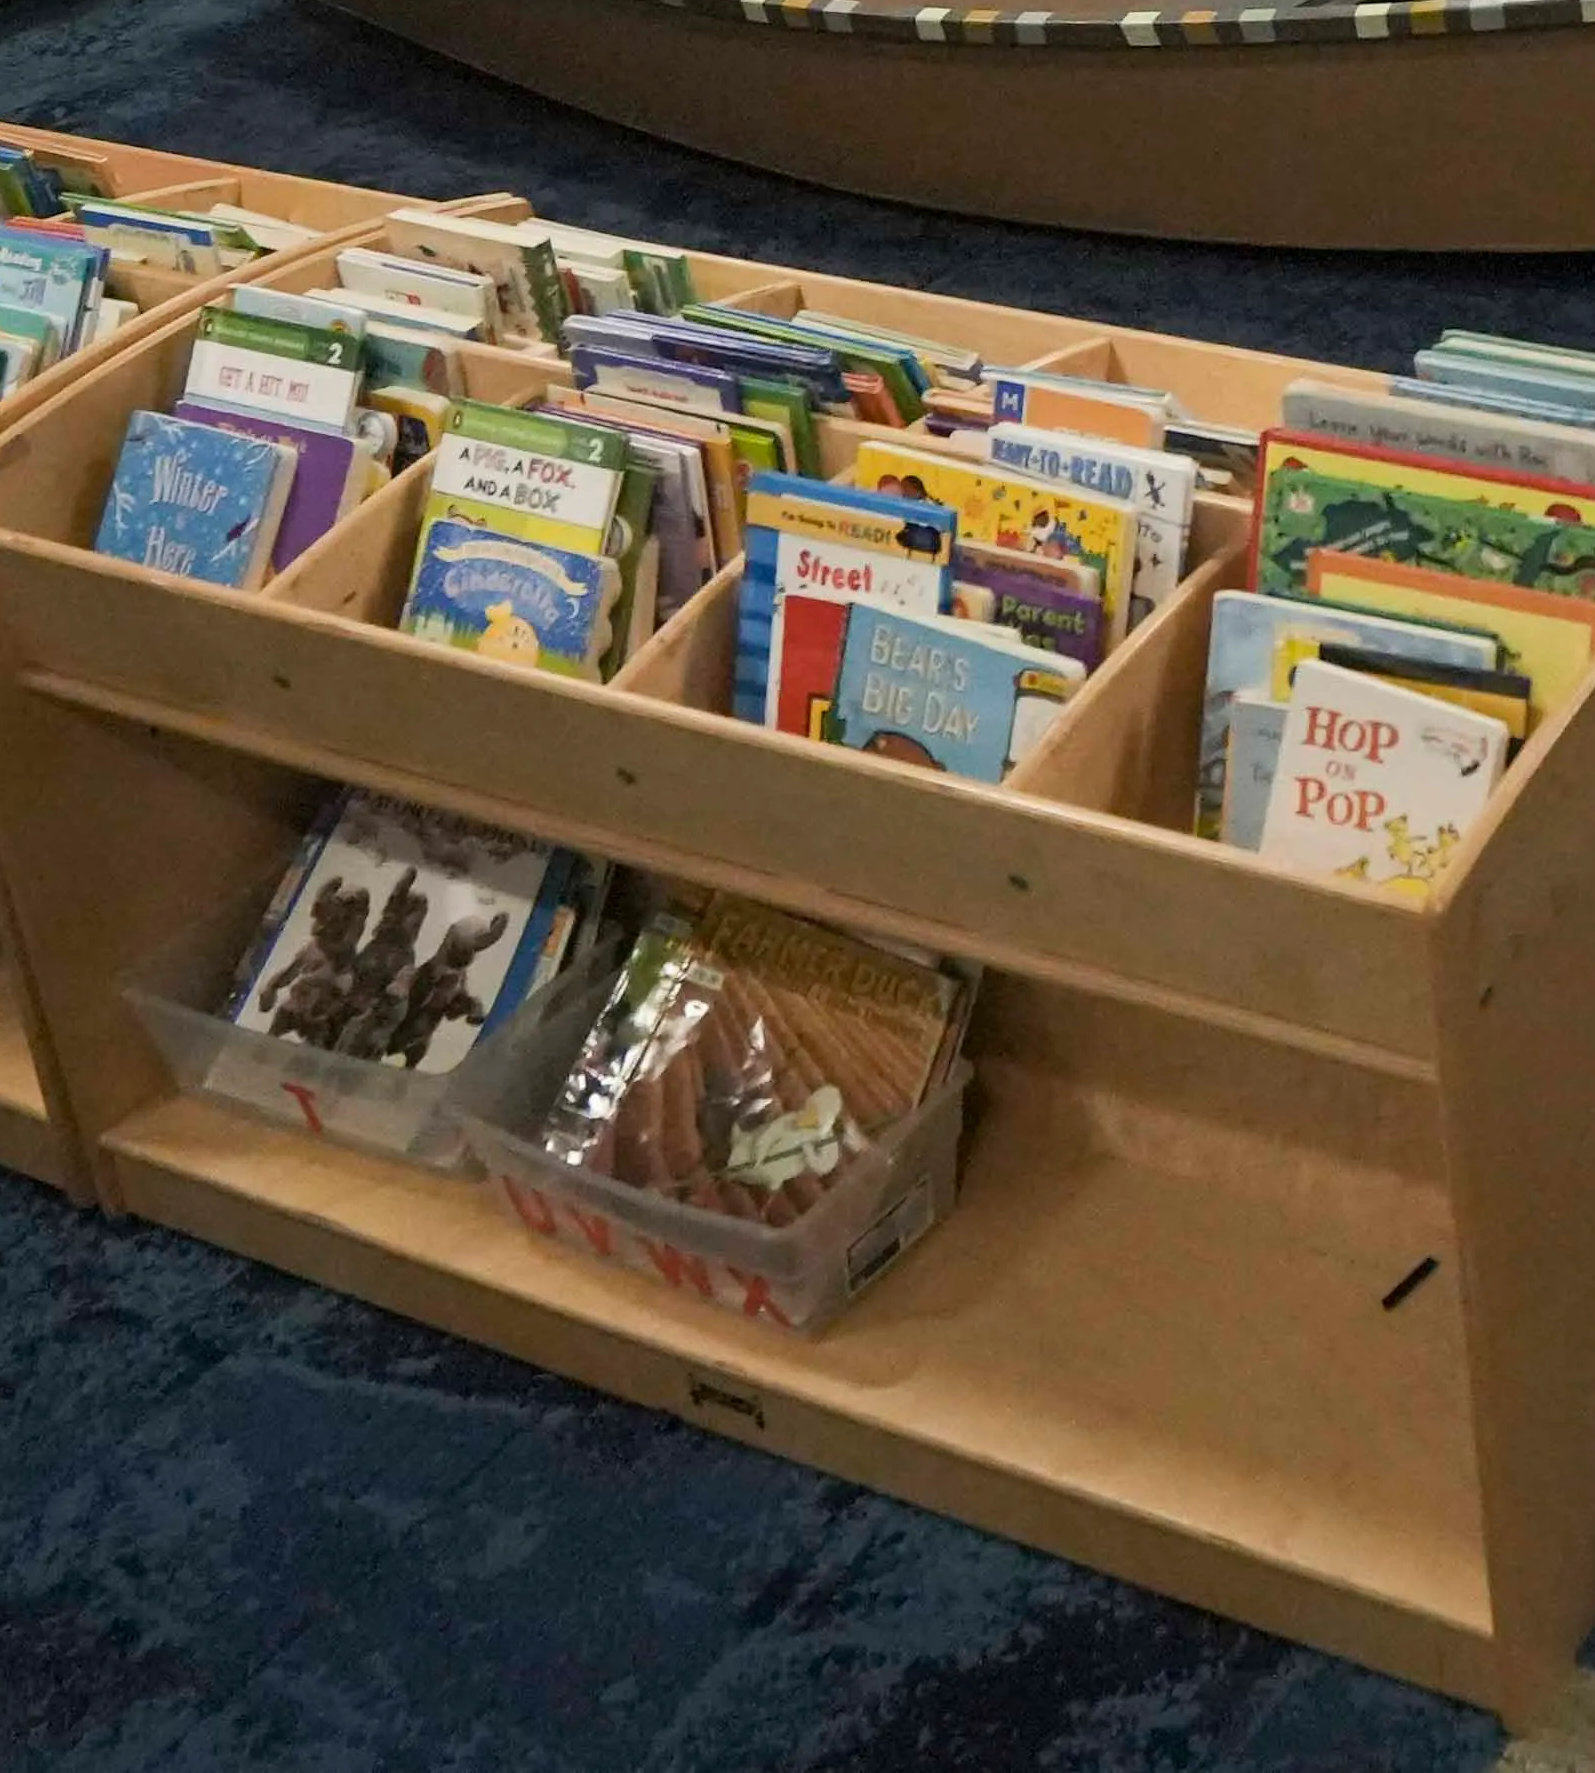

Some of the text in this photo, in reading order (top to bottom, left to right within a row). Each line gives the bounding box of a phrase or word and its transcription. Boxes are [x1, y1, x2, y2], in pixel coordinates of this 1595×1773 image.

[327, 342, 344, 365] 2
[459, 447, 470, 461] A
[512, 459, 524, 474] A
[588, 438, 605, 464] 2
[149, 450, 228, 517] Winter
[464, 476, 561, 513] AND A BOX
[143, 525, 197, 577] Here
[797, 548, 874, 593] Street
[871, 624, 969, 692] BEAR'S
[862, 671, 913, 725] BIG
[922, 690, 980, 745] DAY
[1300, 706, 1399, 764] HOP
[1294, 776, 1388, 831] POP
